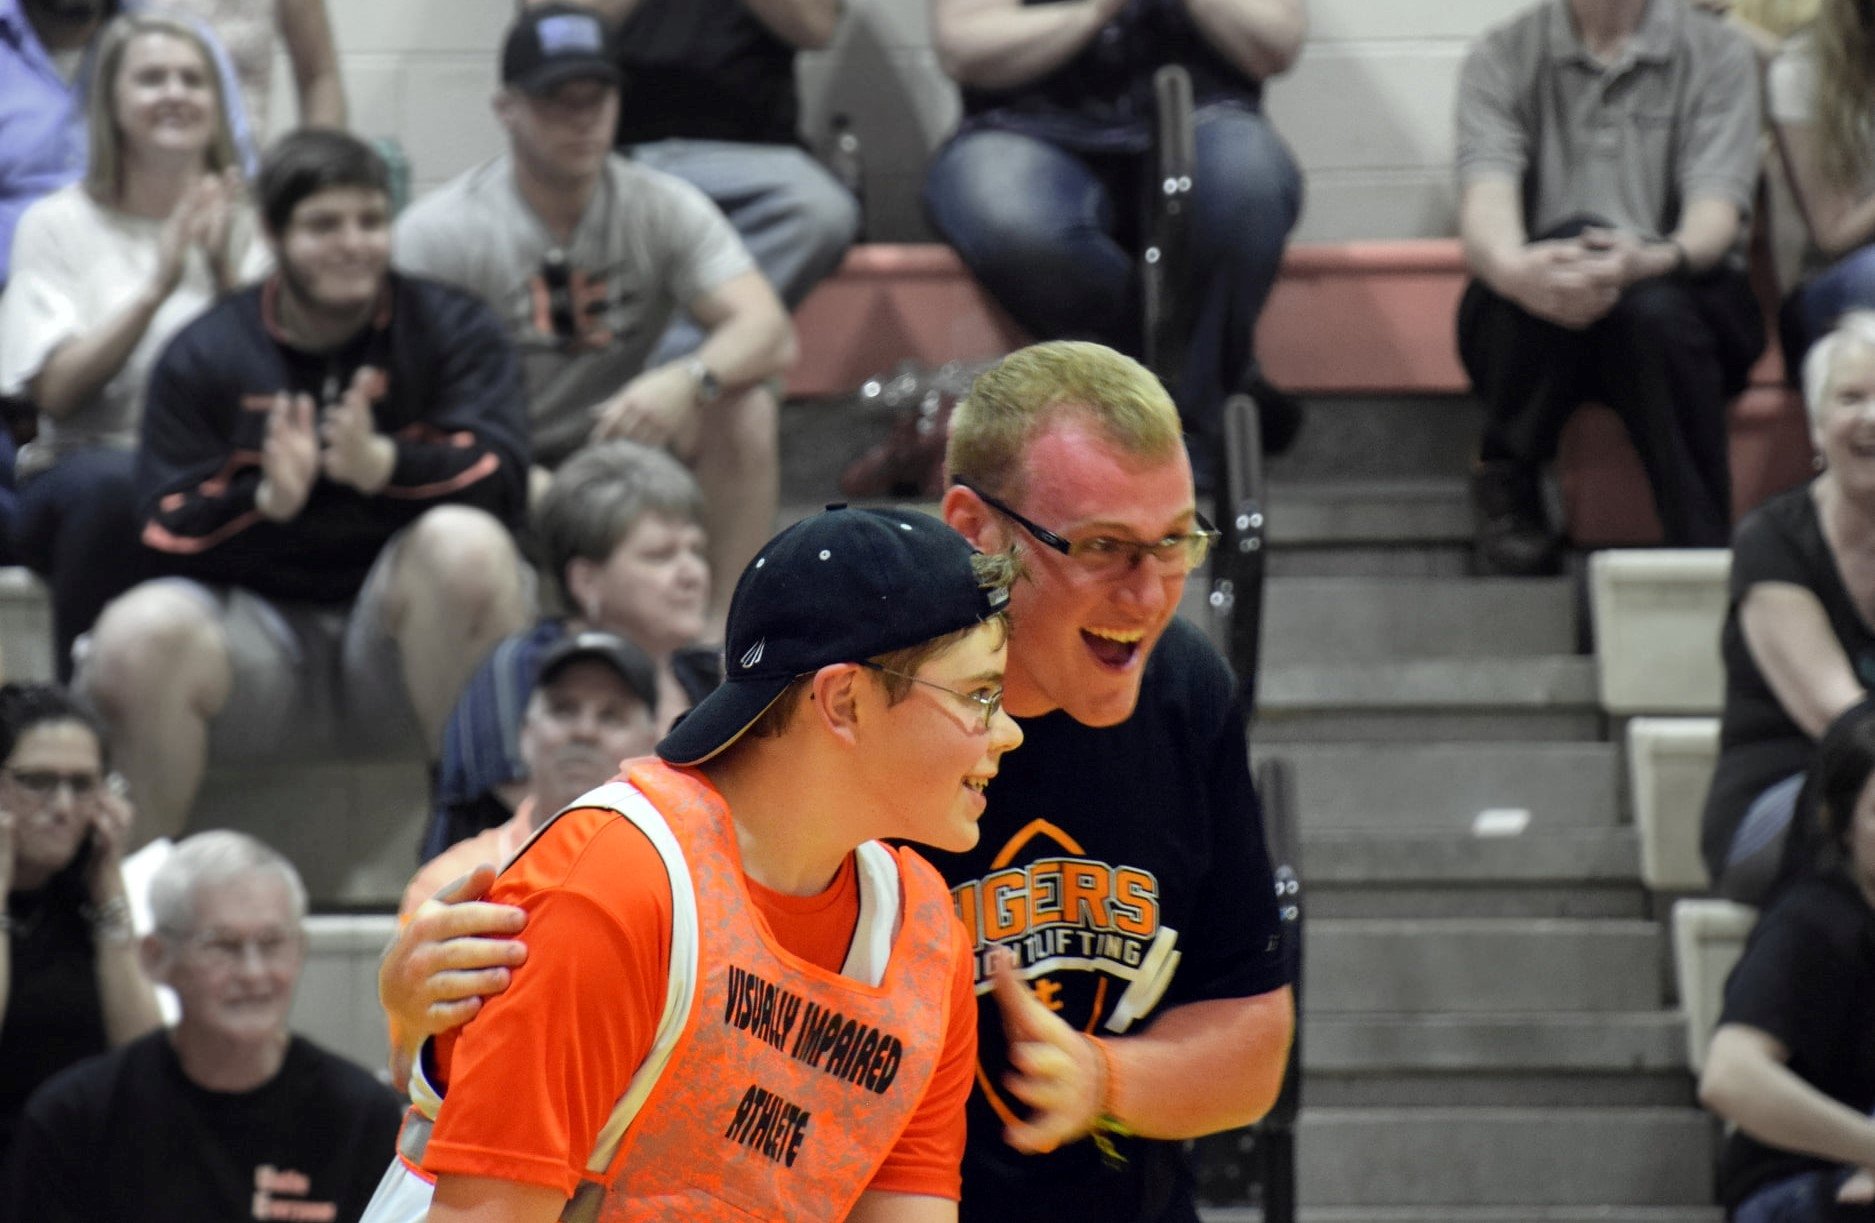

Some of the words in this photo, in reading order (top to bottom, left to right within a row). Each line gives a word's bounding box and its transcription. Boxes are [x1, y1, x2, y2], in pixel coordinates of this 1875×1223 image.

[951, 857, 1160, 952] IGERS
[725, 965, 801, 1052] VISUALLY
[792, 1001, 903, 1094] IMPAIRED
[725, 1084, 811, 1168] ATHLETE
